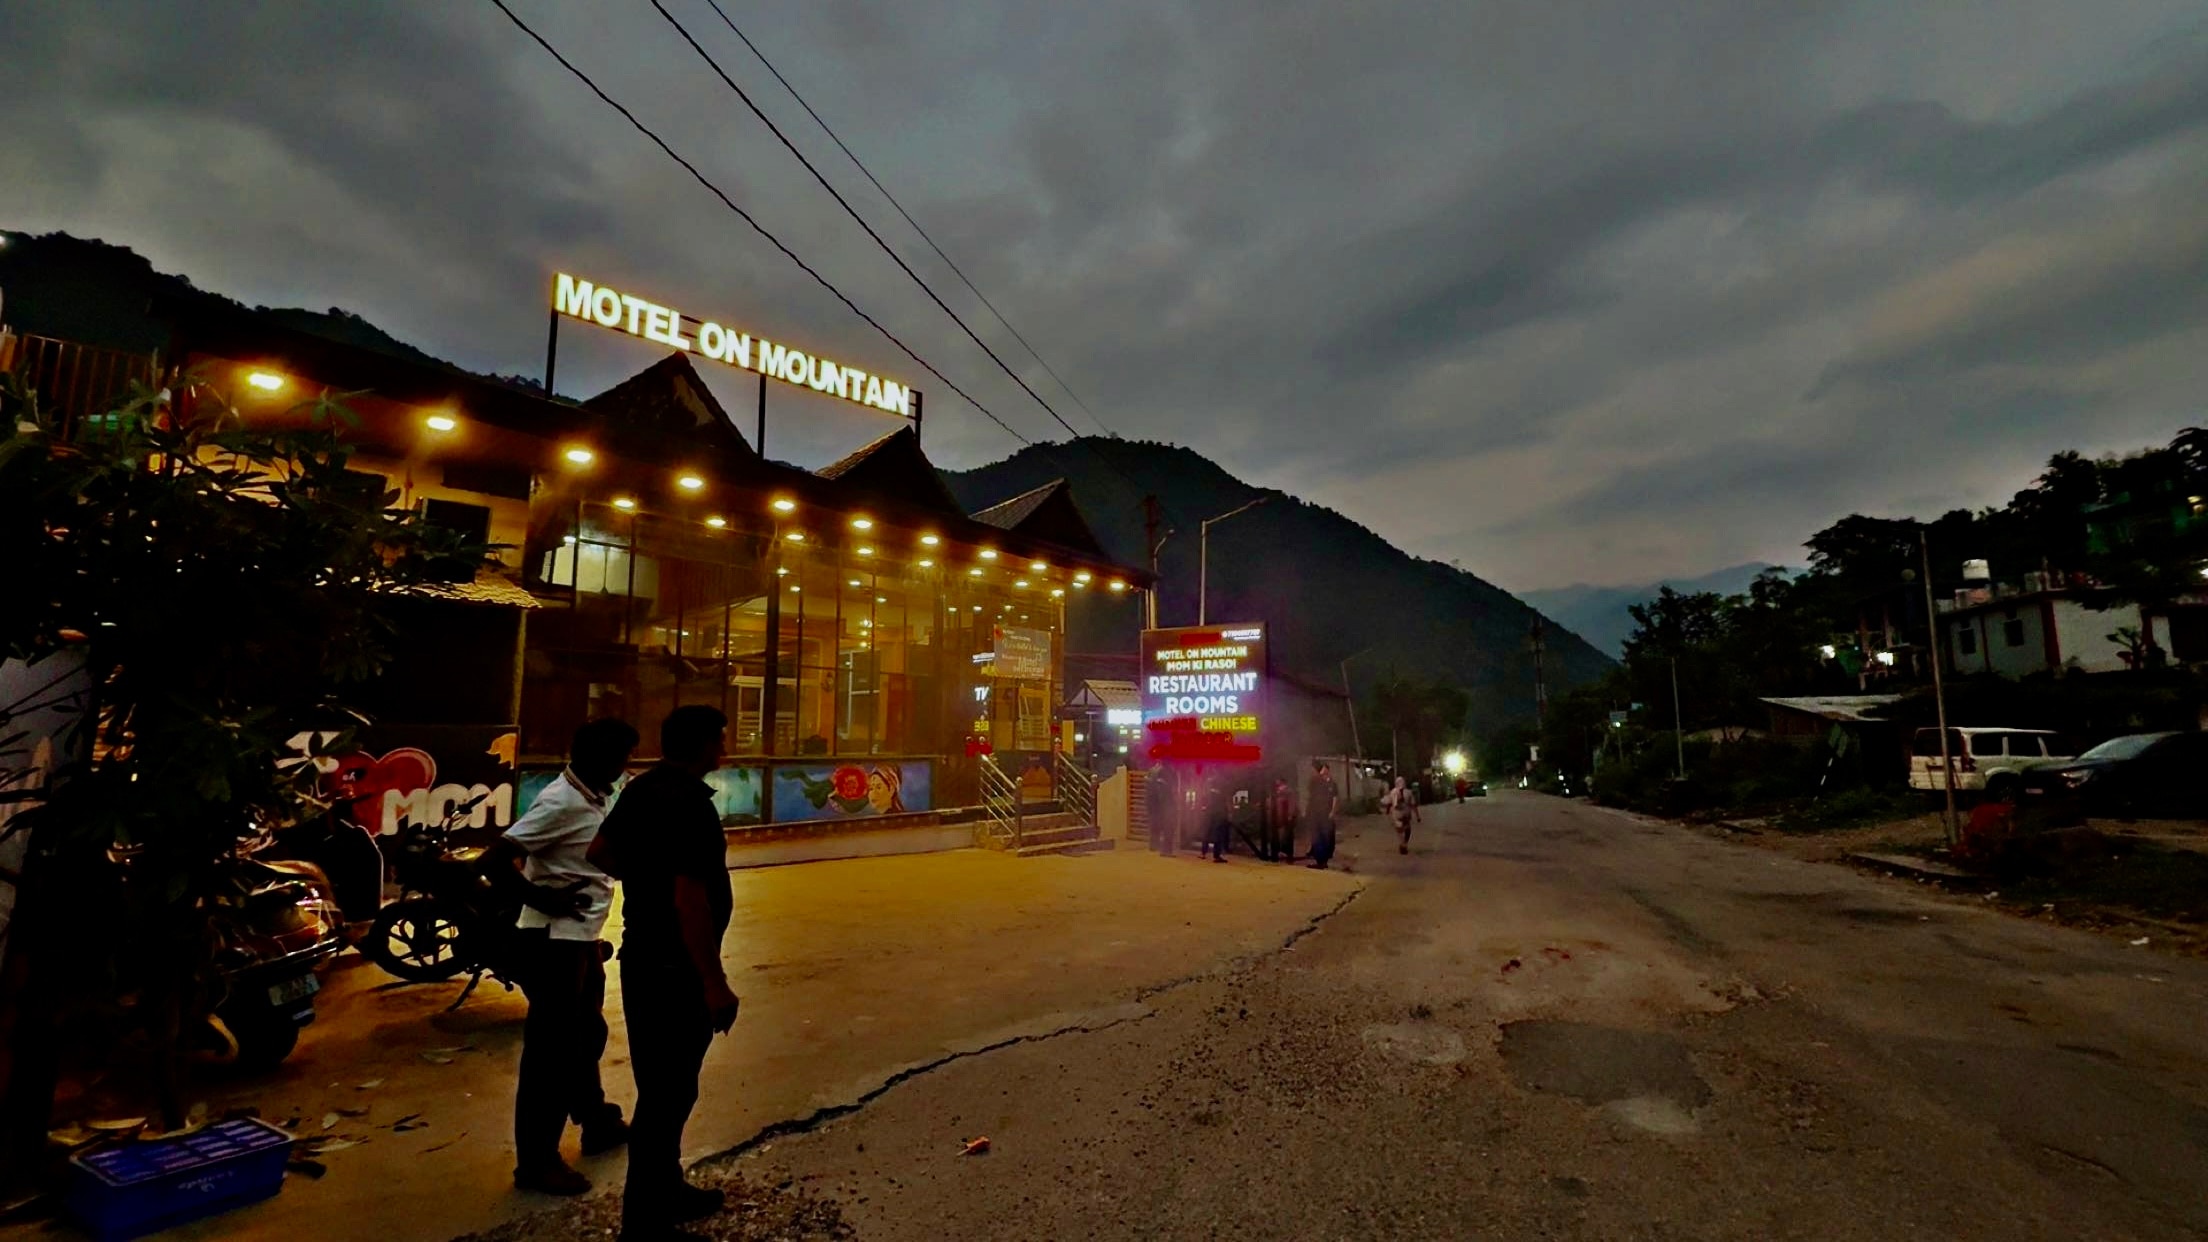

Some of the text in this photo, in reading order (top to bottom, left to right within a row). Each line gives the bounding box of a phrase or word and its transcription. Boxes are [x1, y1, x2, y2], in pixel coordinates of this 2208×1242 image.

[556, 272, 909, 415] MOTEL ON MOUNTAIN
[1157, 646, 1247, 660] MOTEL ON MOUNTAIN
[1167, 661, 1190, 671] MOM
[1149, 672, 1257, 694] RESTAURANT
[1166, 695, 1238, 714] ROOMS
[1201, 717, 1256, 730] CHINESE
[382, 783, 513, 836] MOM
